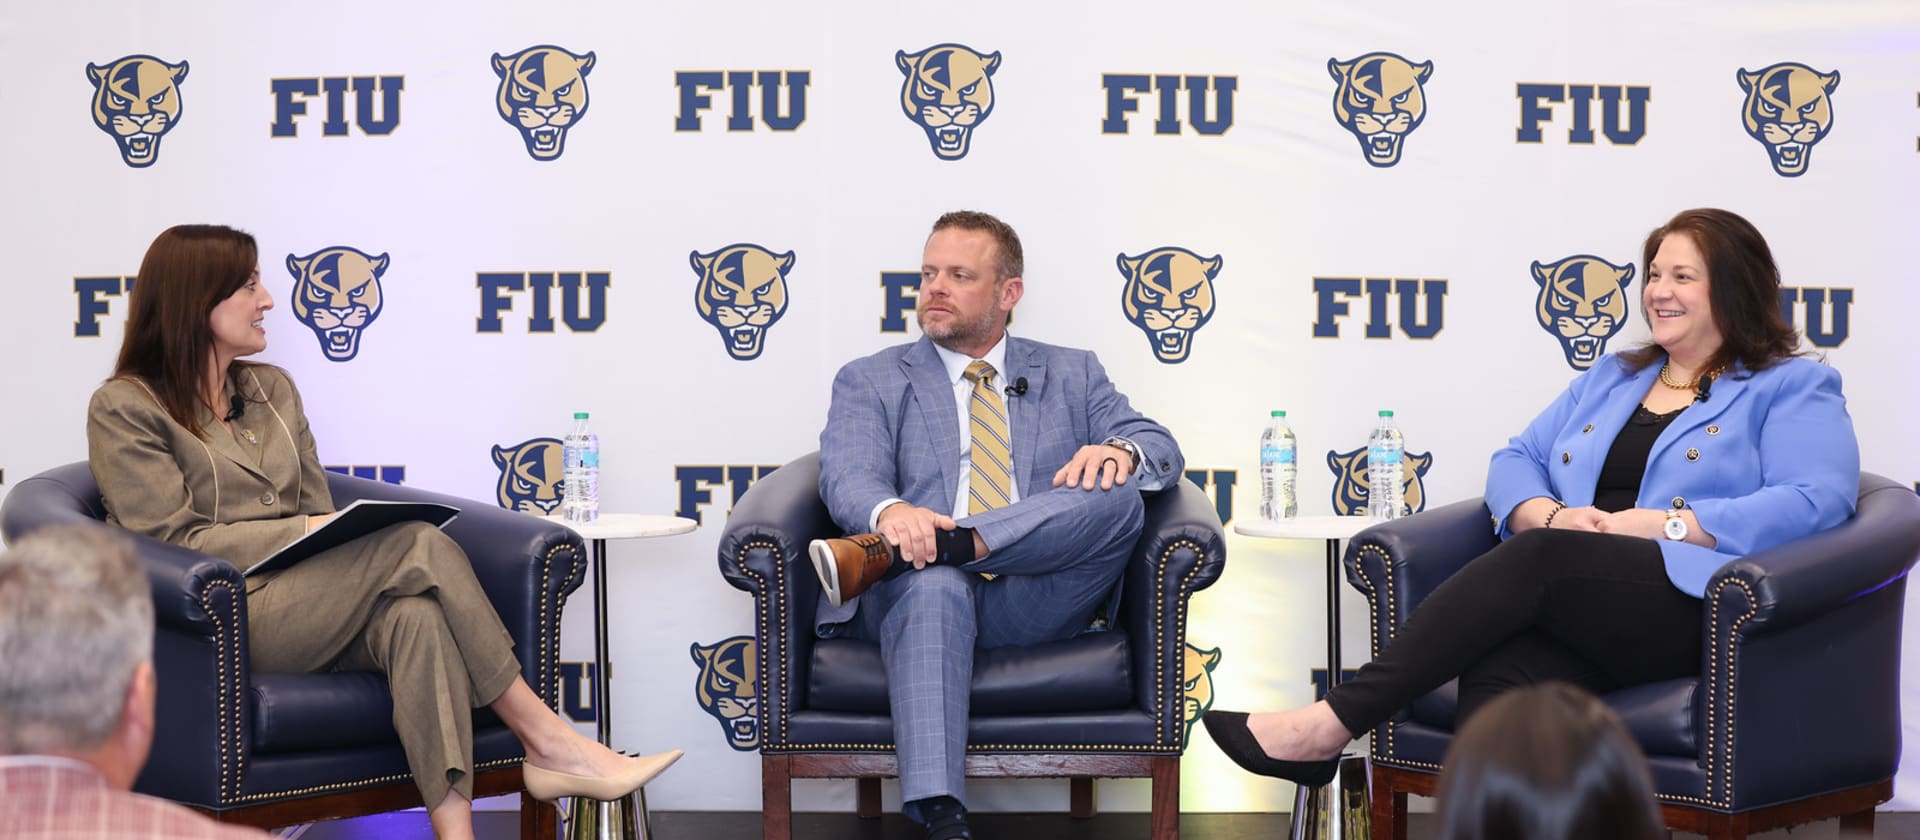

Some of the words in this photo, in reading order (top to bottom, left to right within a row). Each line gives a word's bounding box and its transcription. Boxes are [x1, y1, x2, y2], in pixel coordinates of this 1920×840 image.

[270, 75, 405, 138] FIU
[674, 70, 811, 132] FIU
[1101, 73, 1238, 137] FIU
[1516, 82, 1651, 146] FIU
[476, 271, 611, 334] FIU
[1312, 276, 1448, 340] FIU
